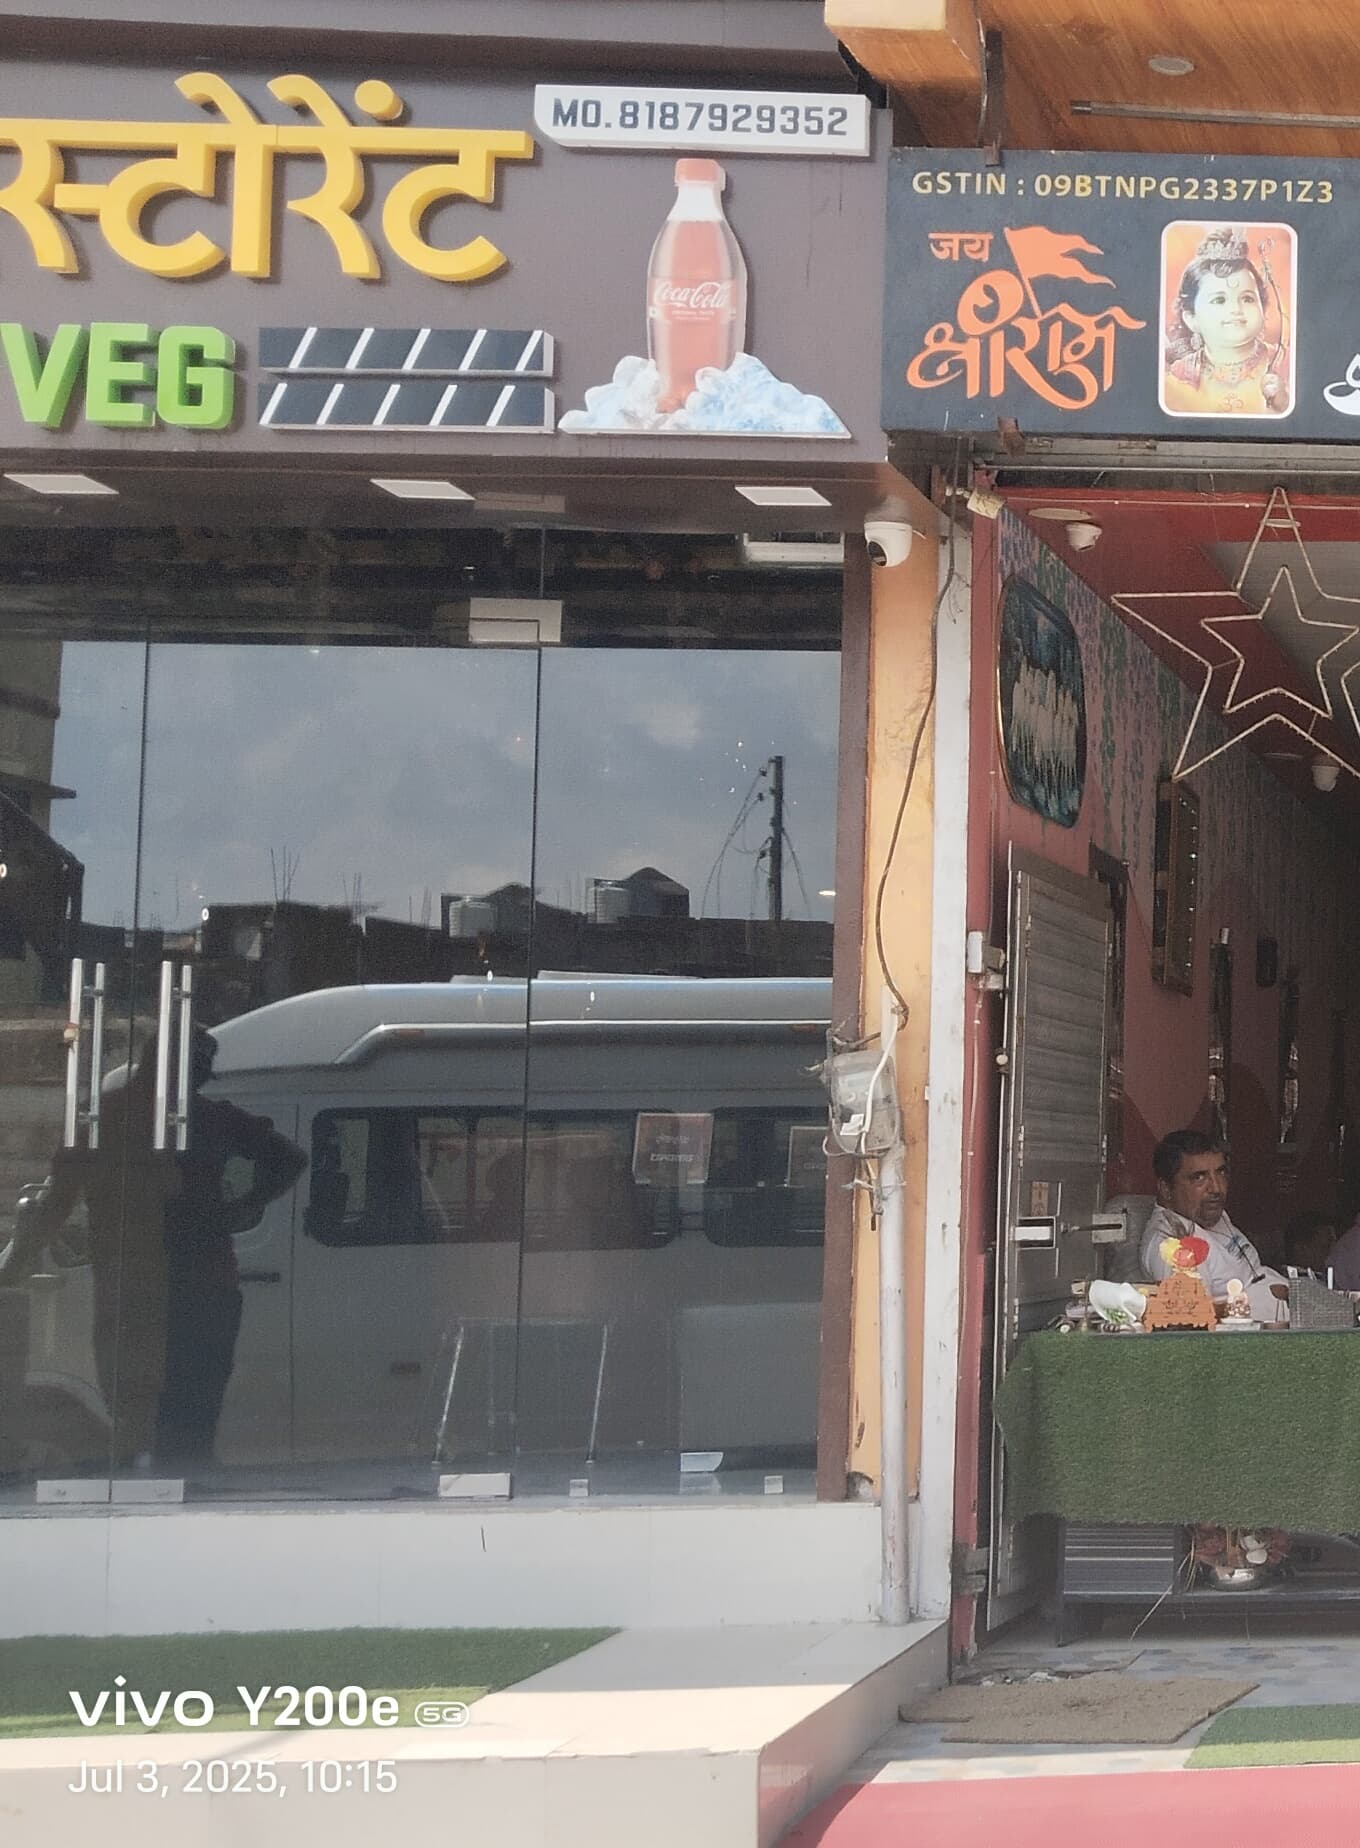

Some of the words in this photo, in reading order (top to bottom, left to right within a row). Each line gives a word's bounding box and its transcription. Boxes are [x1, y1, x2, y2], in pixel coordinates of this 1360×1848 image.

[552, 97, 849, 136] MO.8187929352
[912, 171, 1006, 196] GSTIN
[1034, 173, 1334, 203] 09BTNPG2337P1Z3
[928, 231, 994, 262] जय
[0, 322, 236, 430] VEG
